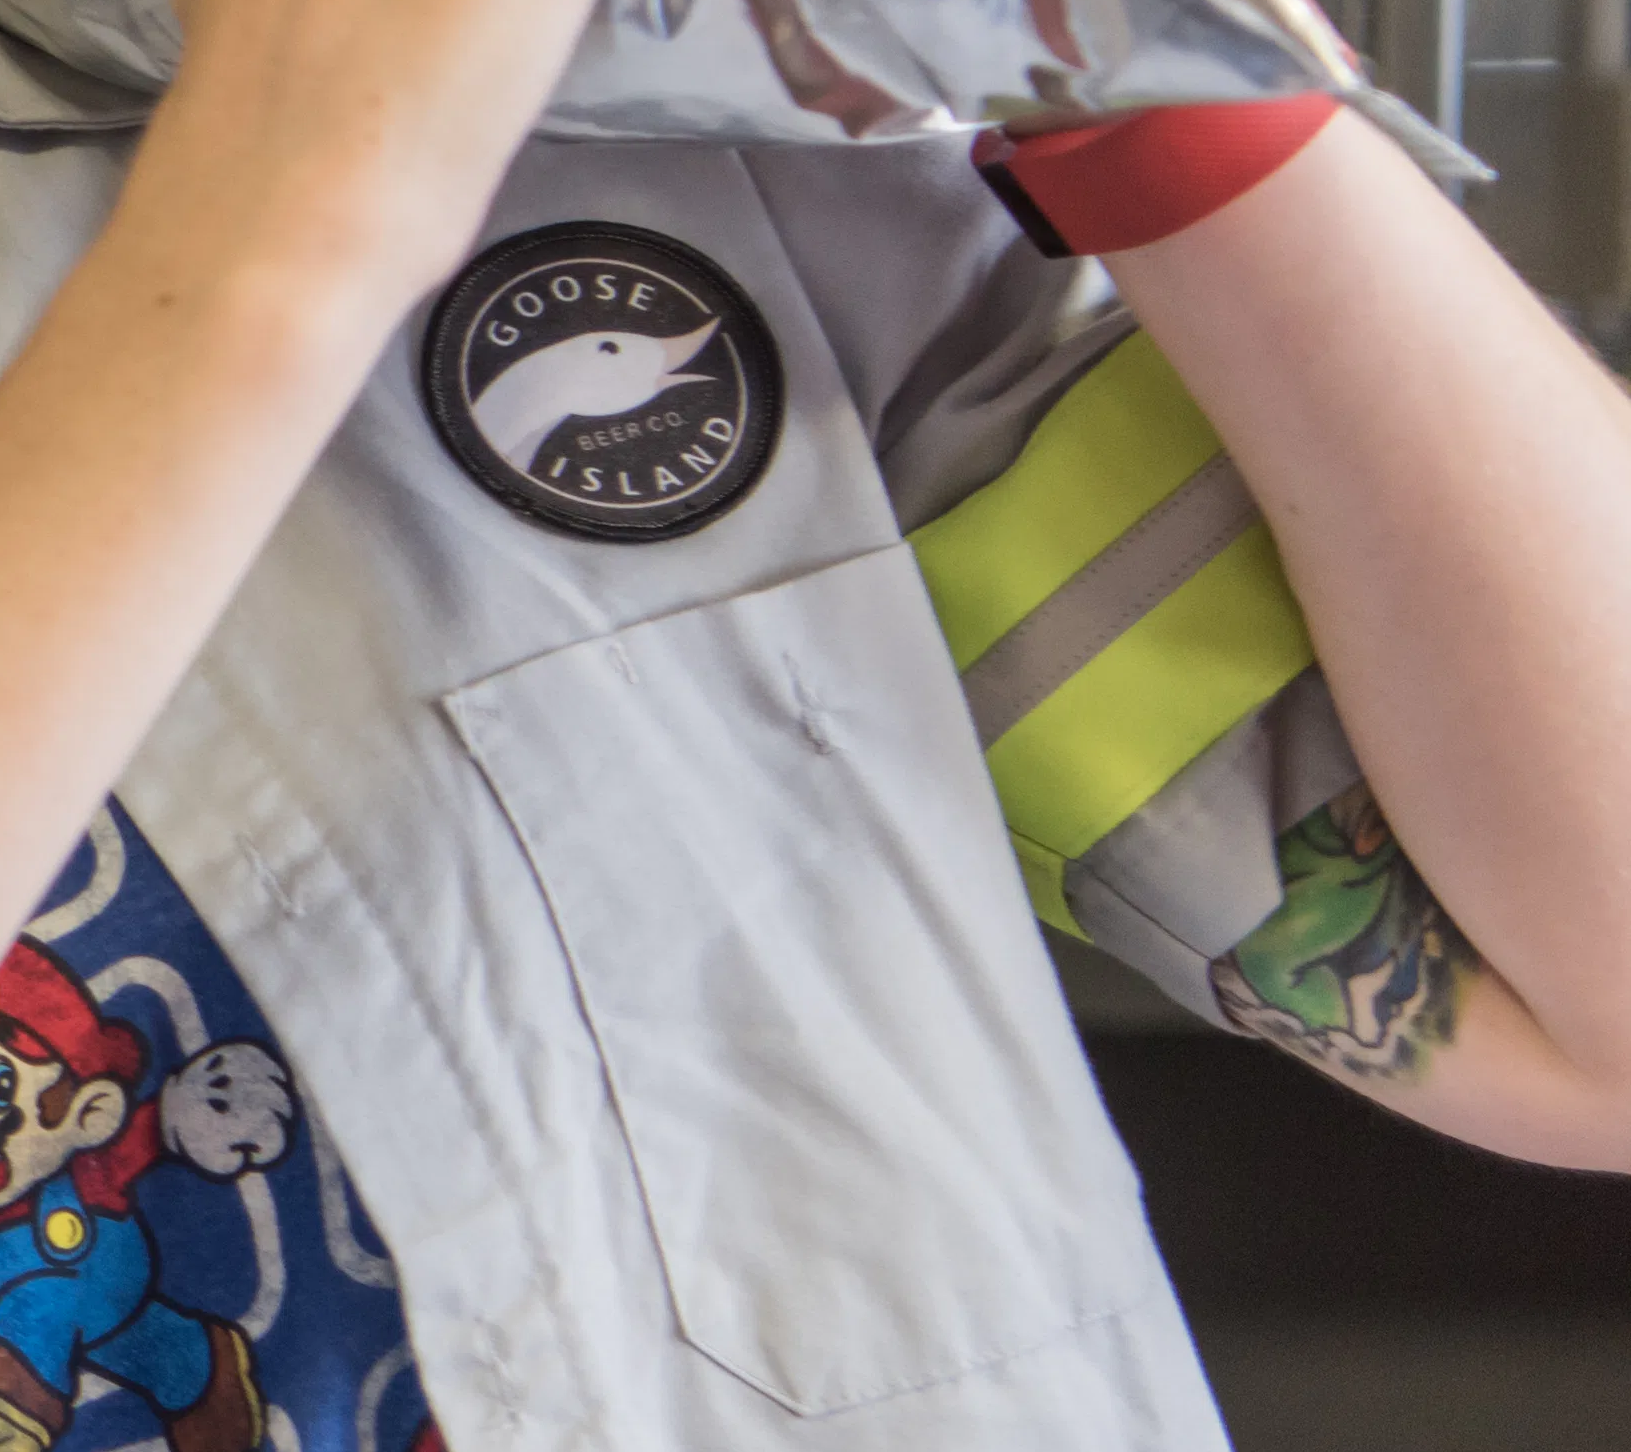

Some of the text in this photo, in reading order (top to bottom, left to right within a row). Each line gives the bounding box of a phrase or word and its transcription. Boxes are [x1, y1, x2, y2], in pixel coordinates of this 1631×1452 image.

[486, 273, 657, 347] GOOSE
[547, 416, 735, 496] ISLAND
[576, 422, 642, 451] BEER
